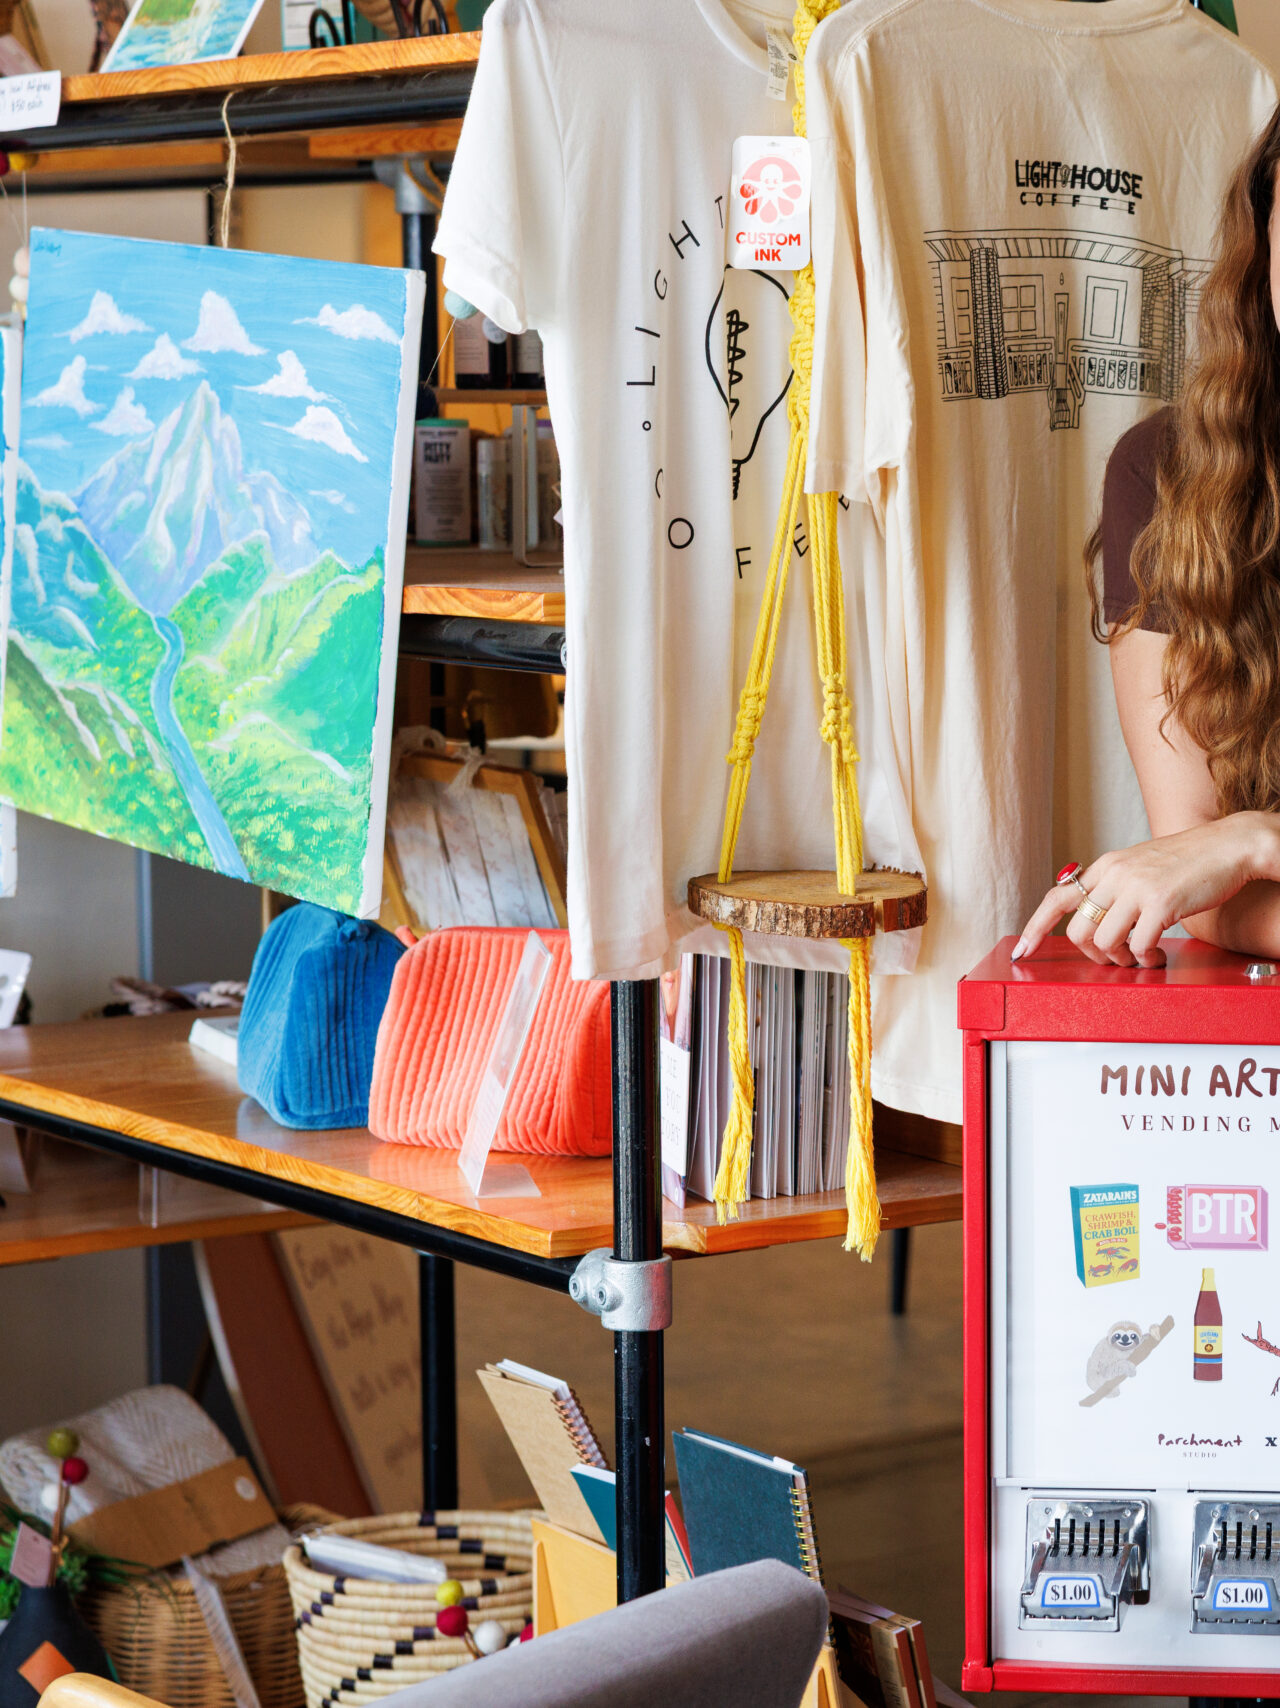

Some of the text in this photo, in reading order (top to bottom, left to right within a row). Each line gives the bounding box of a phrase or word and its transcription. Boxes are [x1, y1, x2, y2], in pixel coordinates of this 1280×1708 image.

[1015, 159, 1143, 199] LIGHT HOUSE
[1020, 192, 1136, 215] COFFEE
[736, 231, 801, 246] CUSTOM
[755, 248, 782, 262] INK
[1101, 1064, 1192, 1096] MINI
[1121, 1115, 1252, 1132] VENDING
[1192, 1192, 1257, 1235] BTR
[1088, 1220, 1124, 1231] SHRIMP
[1084, 1229, 1113, 1240] CRAB
[1157, 1433, 1243, 1448] Parchment
[1051, 1584, 1093, 1603] $1.00
[1221, 1587, 1264, 1605] $1.00
